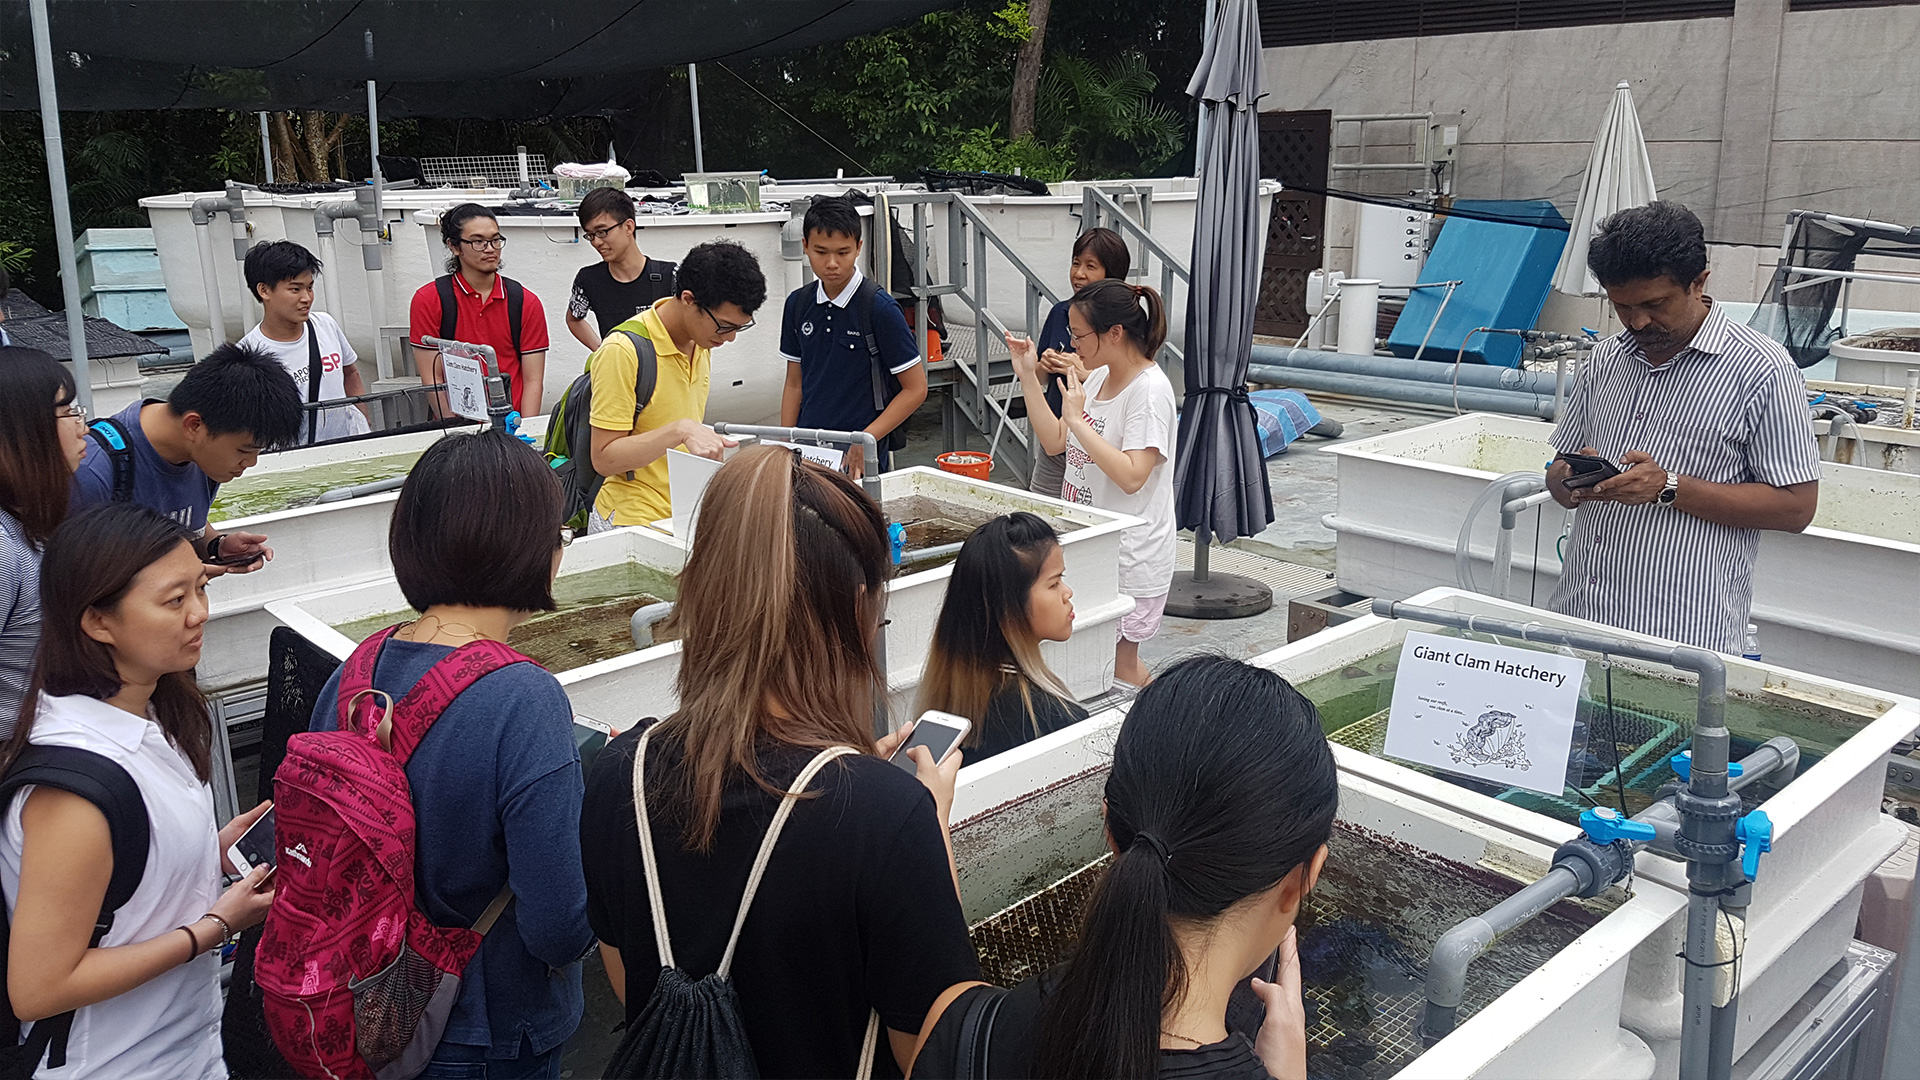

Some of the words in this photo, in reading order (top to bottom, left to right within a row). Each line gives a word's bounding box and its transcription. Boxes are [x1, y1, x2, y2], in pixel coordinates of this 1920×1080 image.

[321, 353, 341, 372] SP
[1413, 646, 1451, 664] Giant
[1454, 653, 1490, 671] Clam
[1494, 660, 1566, 688] Hatchery
